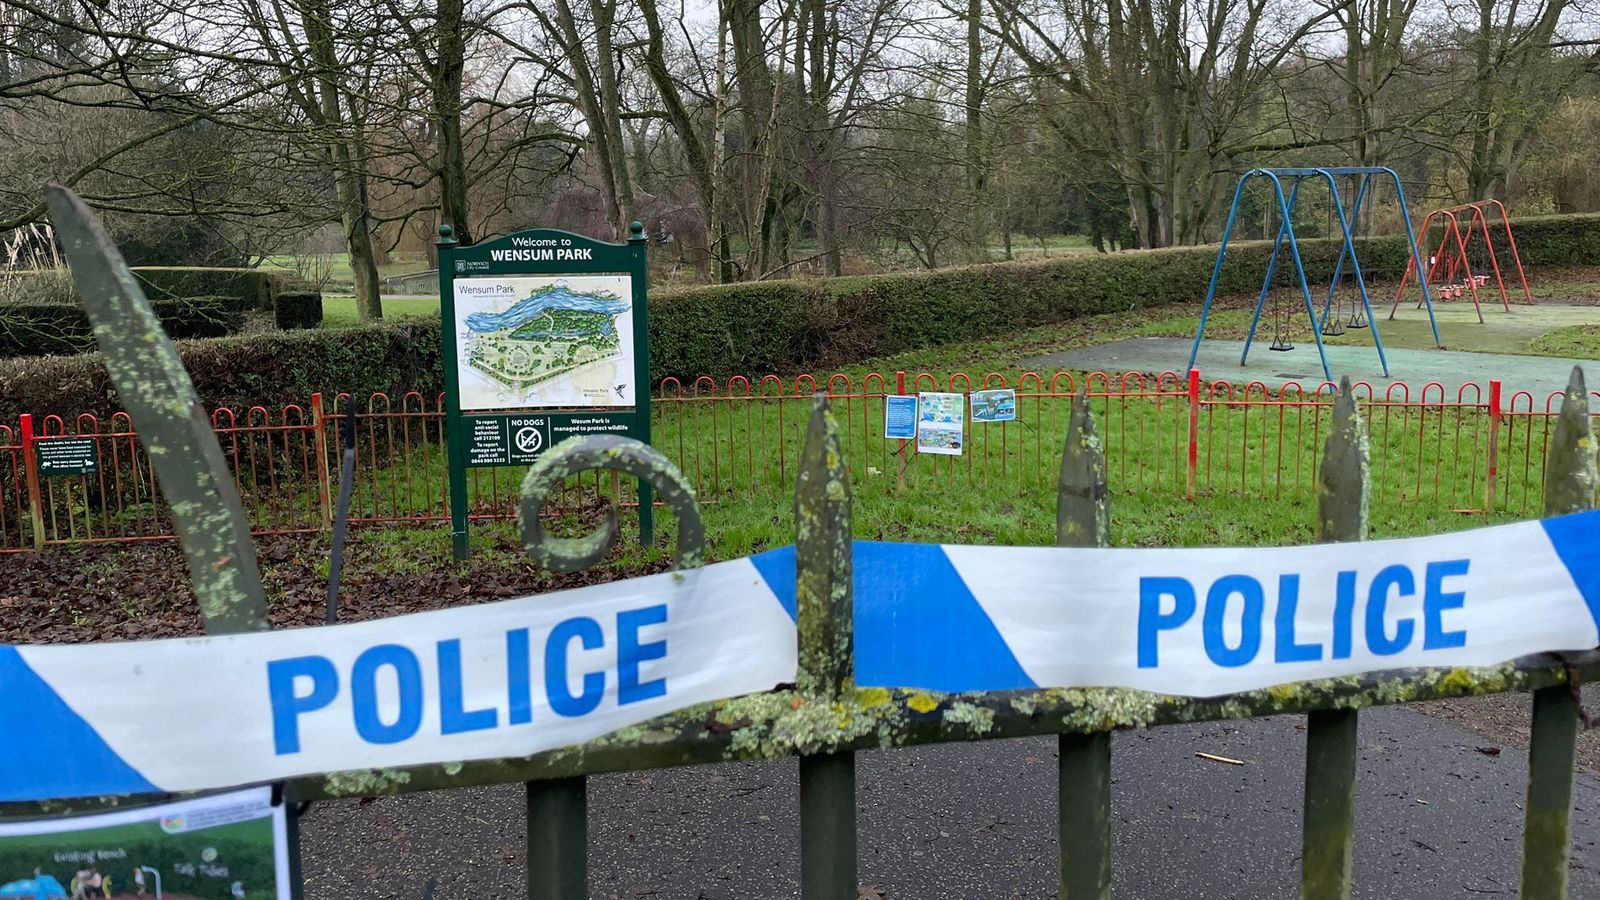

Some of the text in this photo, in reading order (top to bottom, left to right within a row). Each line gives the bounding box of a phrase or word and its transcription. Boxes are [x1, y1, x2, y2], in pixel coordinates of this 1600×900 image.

[512, 237, 571, 247] Welcome to
[490, 248, 592, 261] WENSUM PARK
[459, 285, 515, 295] Wensum Park
[1137, 558, 1471, 669] POLICE
[267, 603, 668, 756] POLICE
